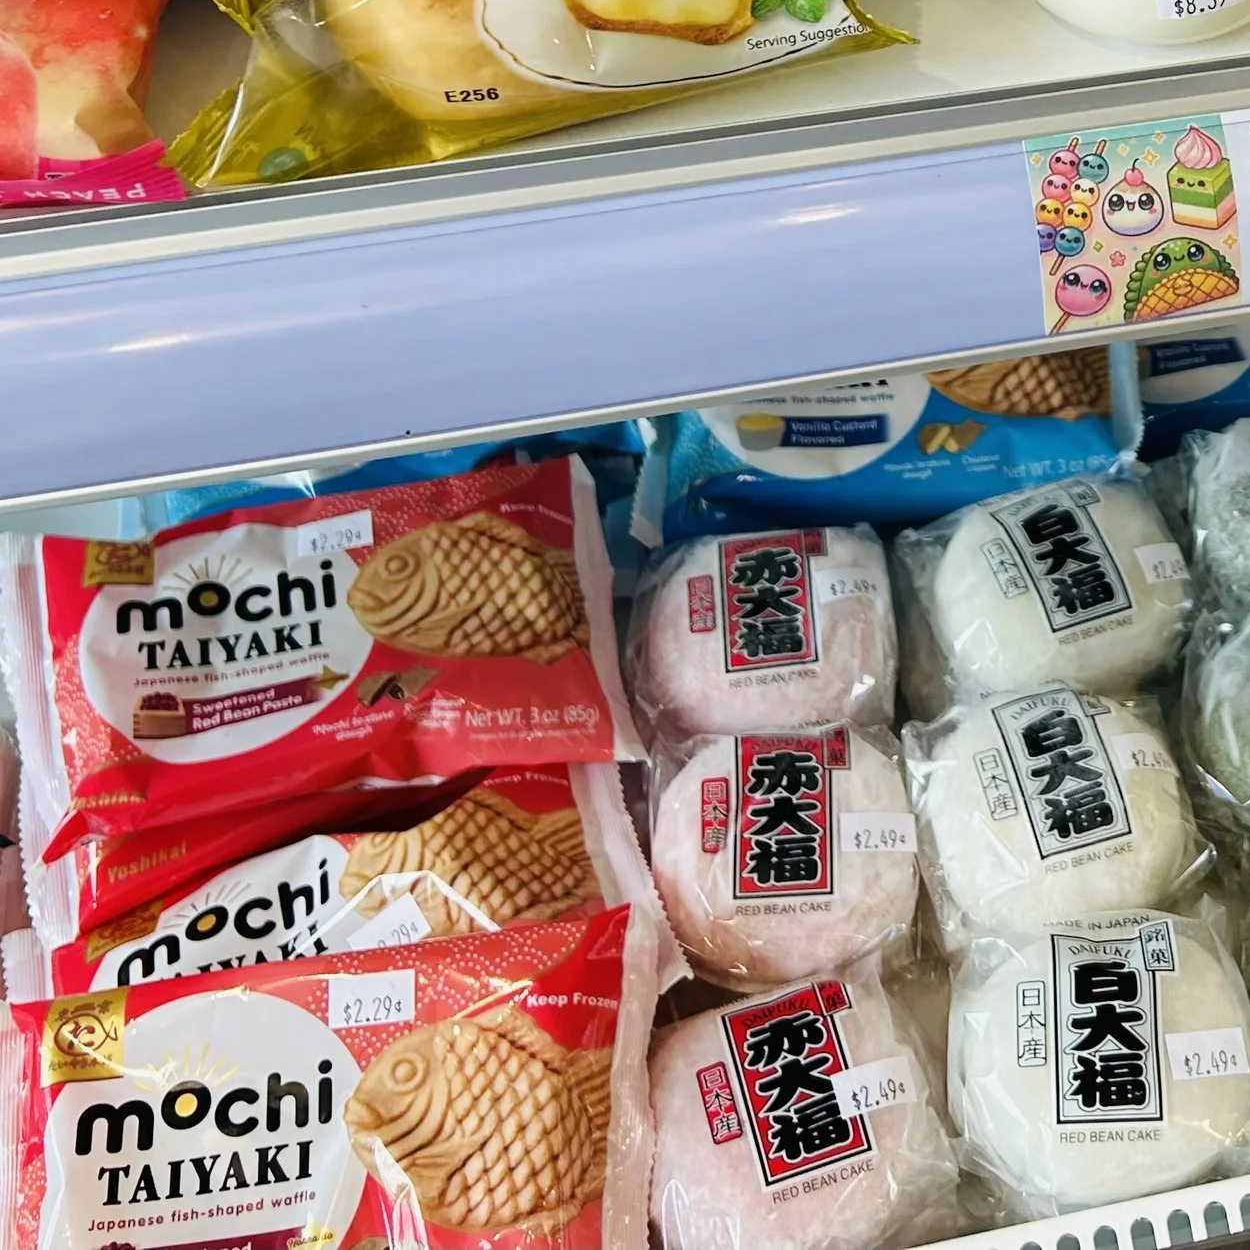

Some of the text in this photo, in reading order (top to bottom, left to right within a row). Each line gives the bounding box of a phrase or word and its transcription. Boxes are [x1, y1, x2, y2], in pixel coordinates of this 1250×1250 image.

[747, 33, 797, 51] Serving
[445, 87, 500, 103] E256
[986, 543, 1027, 596] 日本産
[1020, 503, 1114, 613] 白大福
[115, 558, 338, 634] mochi
[731, 547, 805, 658] 赤大福
[138, 619, 323, 670] TAIYAKI
[133, 651, 330, 688] Japanese fish-shaped waffle
[192, 687, 276, 714] Sweetened
[192, 695, 303, 731] Red Bean Paste
[465, 710, 493, 727] Net
[530, 708, 539, 723] 3
[542, 711, 558, 723] oz
[563, 706, 600, 726] (85g)
[1011, 697, 1071, 720] DAIFUKU
[525, 771, 570, 787] Frozen
[977, 752, 1016, 818] 日本産
[1021, 709, 1113, 839] 白大福
[703, 781, 728, 851] 日本産
[743, 749, 822, 886] 赤大福
[1044, 842, 1134, 875] RED BEAN CAKE
[116, 858, 330, 986] mochi
[735, 901, 832, 916] RED BEAN CAKE
[1087, 915, 1150, 930] IN JAPAN
[343, 1001, 404, 1024] $2.29¢
[526, 992, 618, 1011] Keep Frozen
[1018, 988, 1046, 1061] 日本産
[1069, 961, 1148, 1108] 白大福
[1184, 1050, 1237, 1076] $2.49¢
[75, 1058, 334, 1156] mochi
[701, 1067, 741, 1138] 日本産
[744, 1011, 852, 1162] 赤大福
[851, 1078, 906, 1110] $2.49¢
[1059, 1129, 1161, 1143] RED BEAN CAKE
[98, 1139, 313, 1207] TAIYAKI
[772, 1160, 875, 1204] RED BEAN CAKE
[88, 1190, 317, 1233] Japanese fish-shaped waffle
